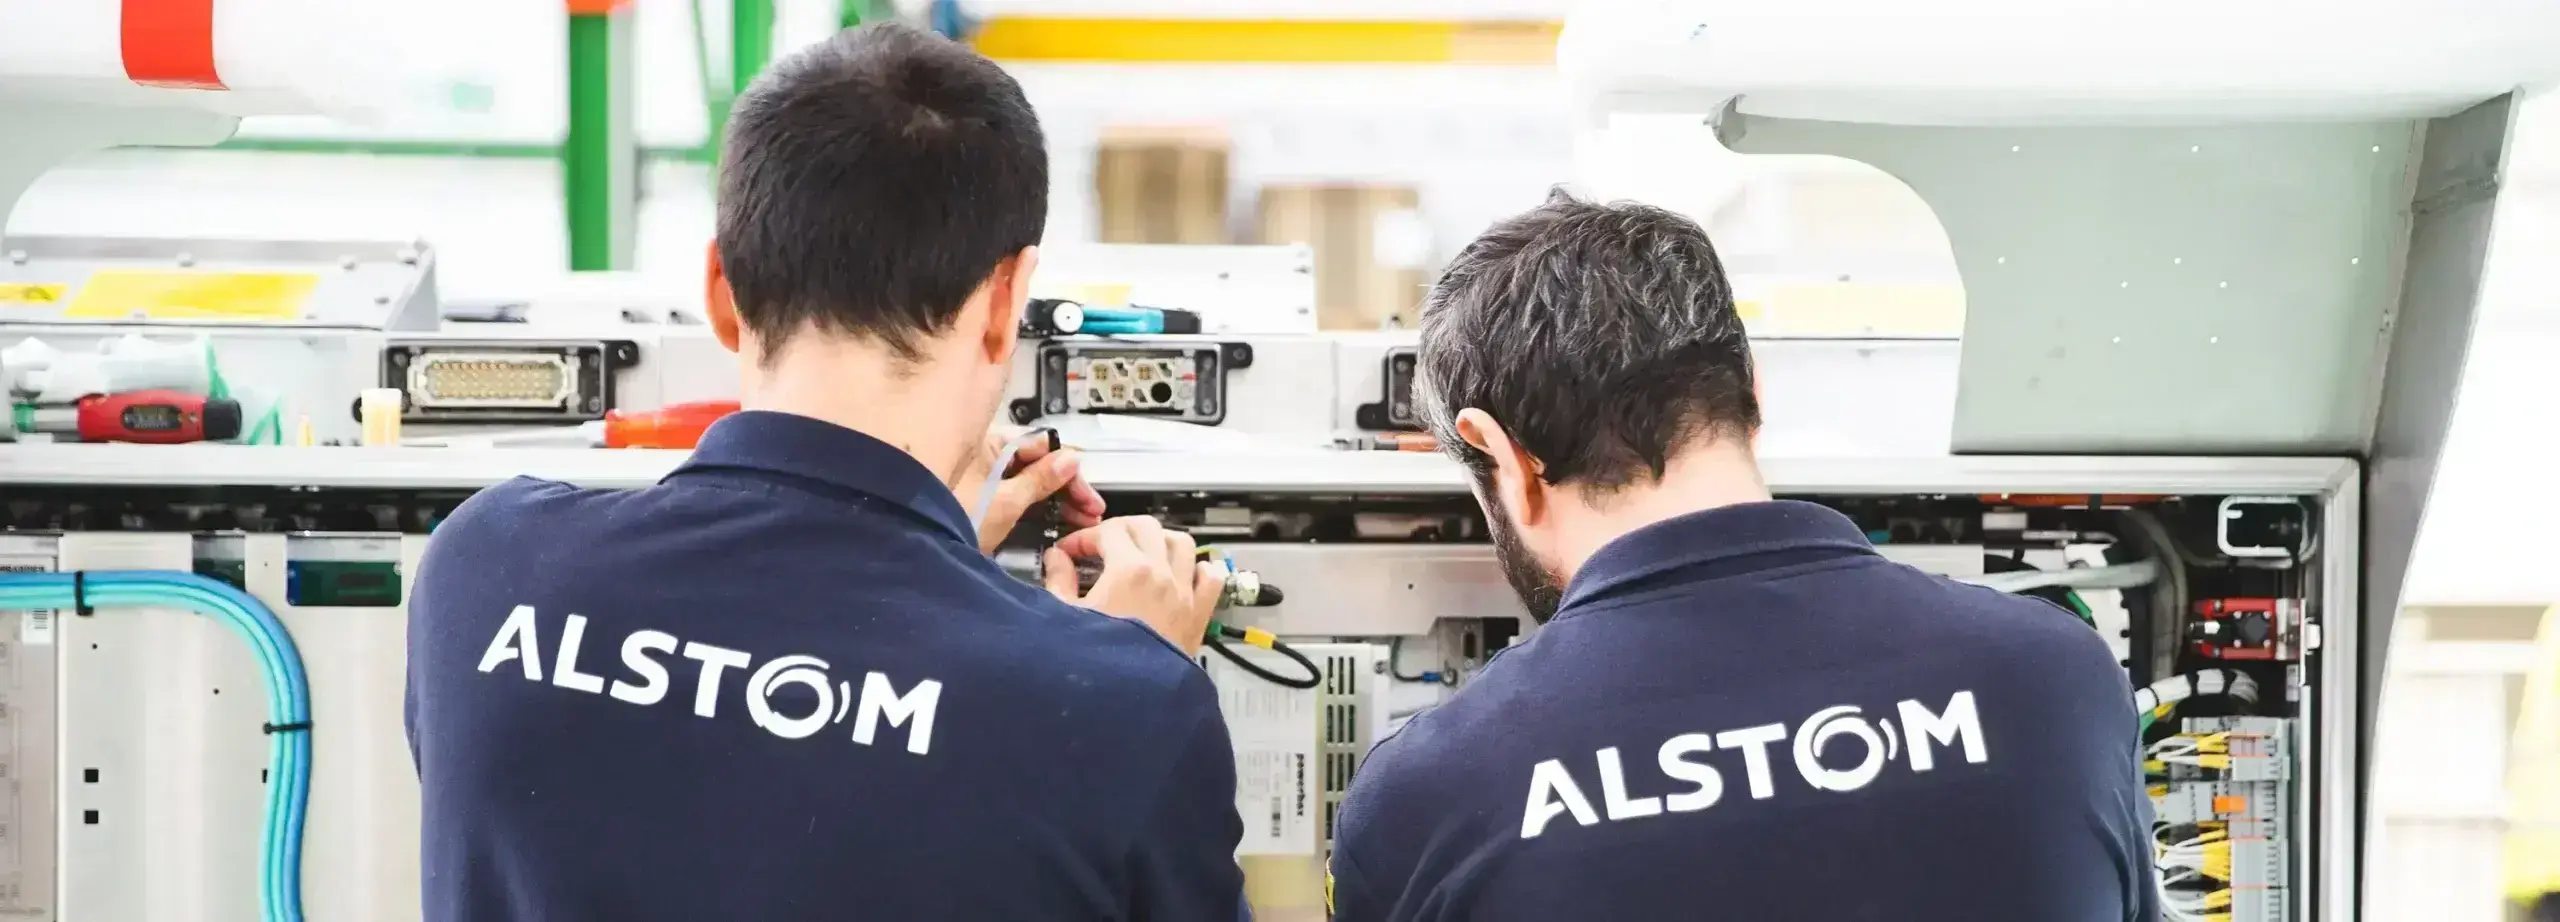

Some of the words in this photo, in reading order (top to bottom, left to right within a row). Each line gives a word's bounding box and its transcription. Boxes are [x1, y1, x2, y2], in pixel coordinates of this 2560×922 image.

[477, 604, 943, 755] ALSTOM
[1295, 752, 1305, 816] powerbox
[1520, 690, 1988, 839] ALSTOM
